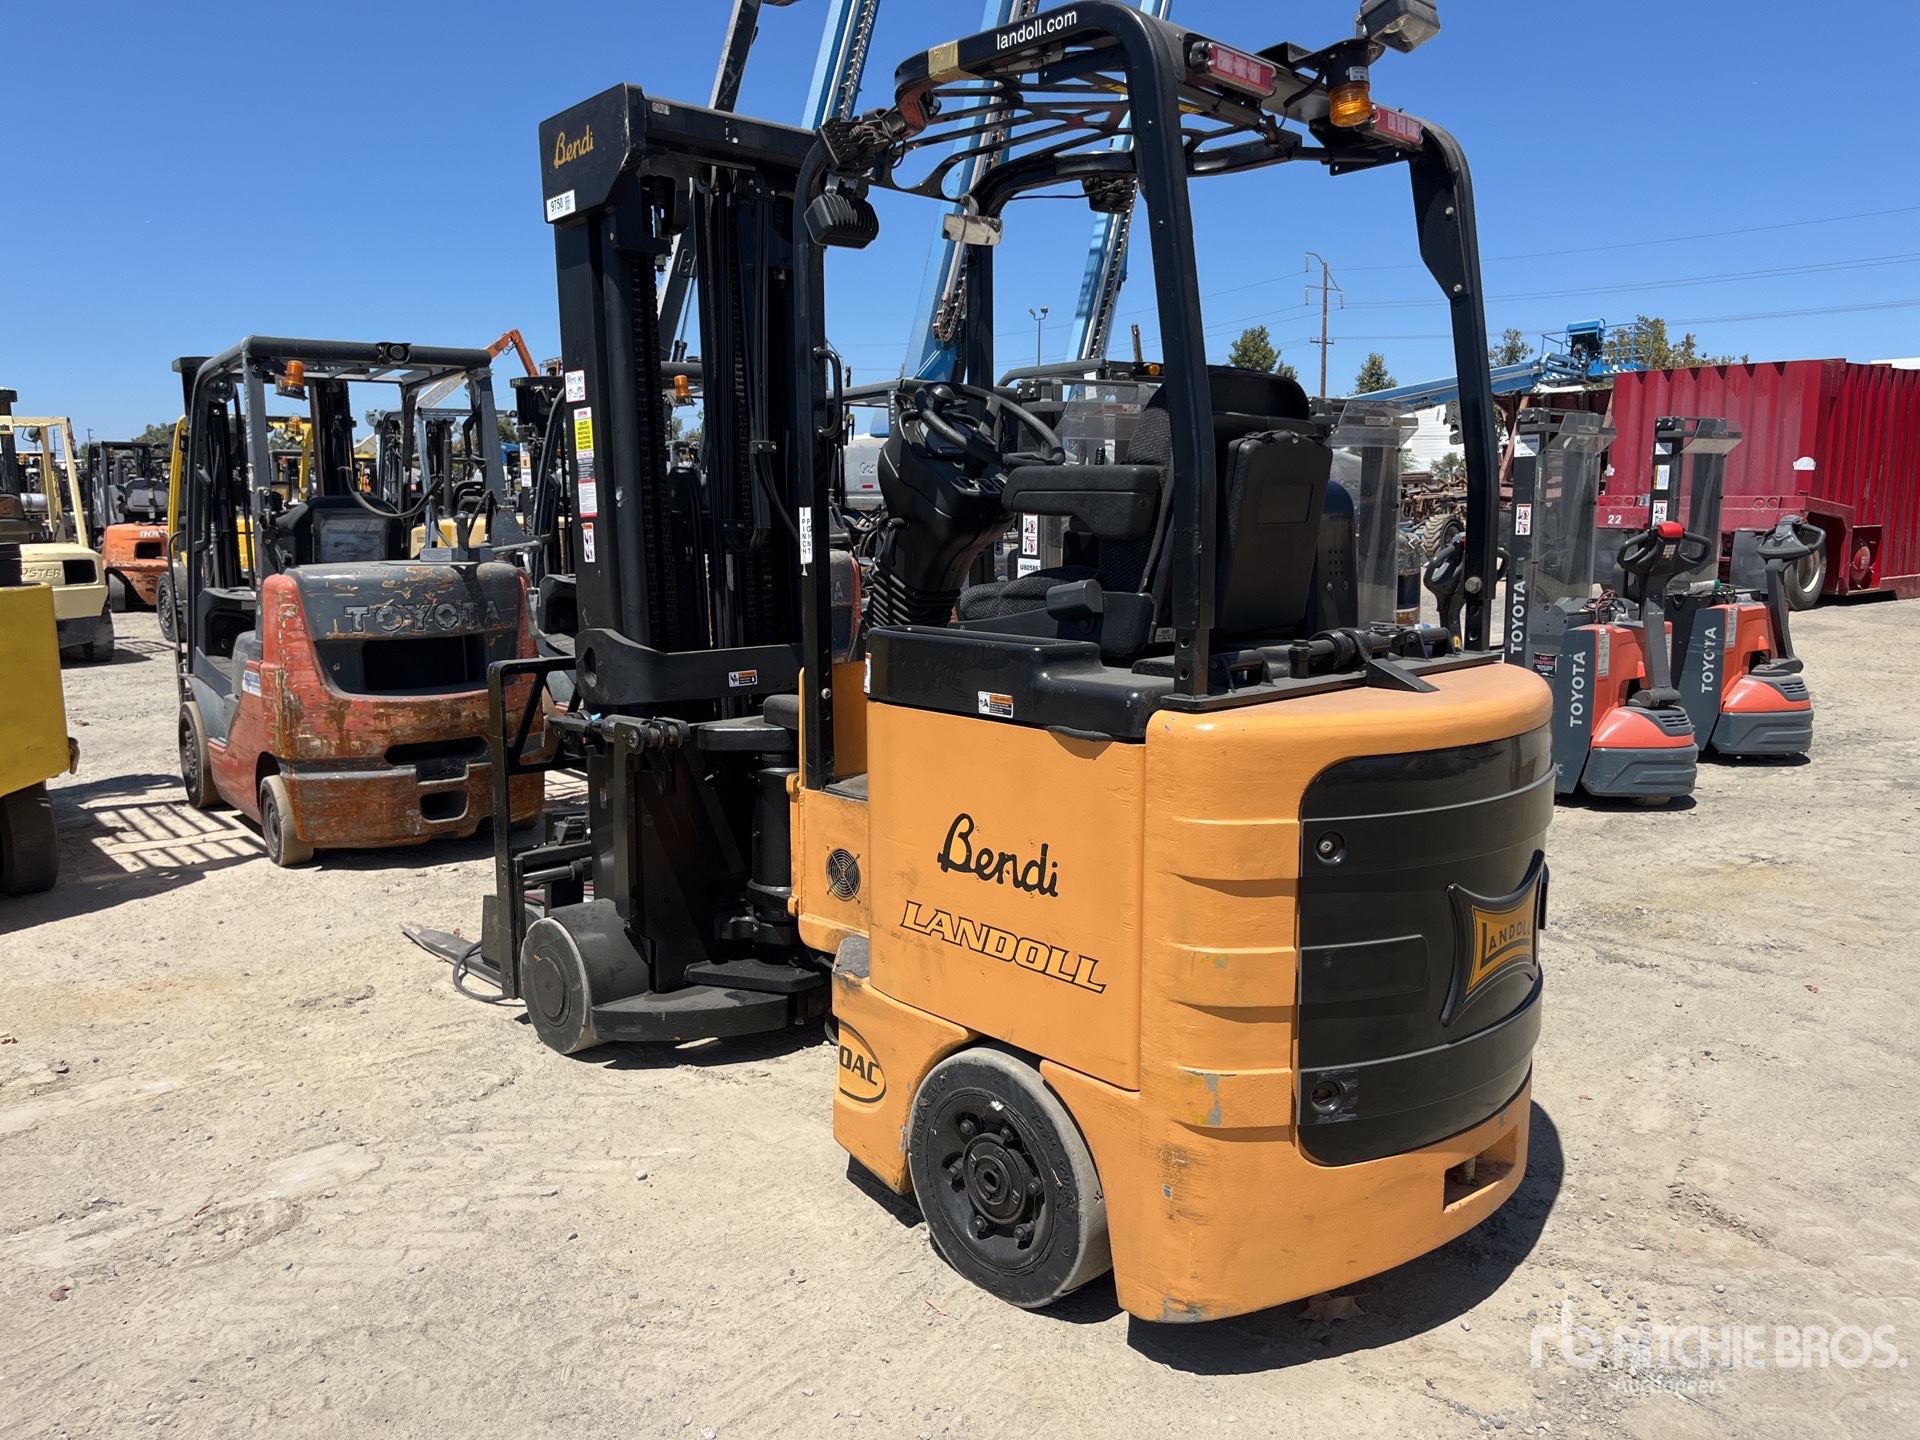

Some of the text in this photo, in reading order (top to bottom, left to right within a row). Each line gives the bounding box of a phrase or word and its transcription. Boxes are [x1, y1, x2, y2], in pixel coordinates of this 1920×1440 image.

[996, 11, 1077, 50] landoll.com
[553, 124, 594, 169] Bendi
[550, 197, 563, 212] 9750
[1608, 514, 1622, 525] 22
[22, 567, 63, 579] YSTER
[344, 600, 502, 633] TOYOTA
[1510, 580, 1526, 655] TOYOTA
[1701, 627, 1717, 694] TOYOTA
[1570, 650, 1586, 728] TOYOTA
[937, 813, 1058, 897] Bendi
[900, 900, 1107, 994] LANDOLL
[1480, 920, 1530, 970] LANDOLL
